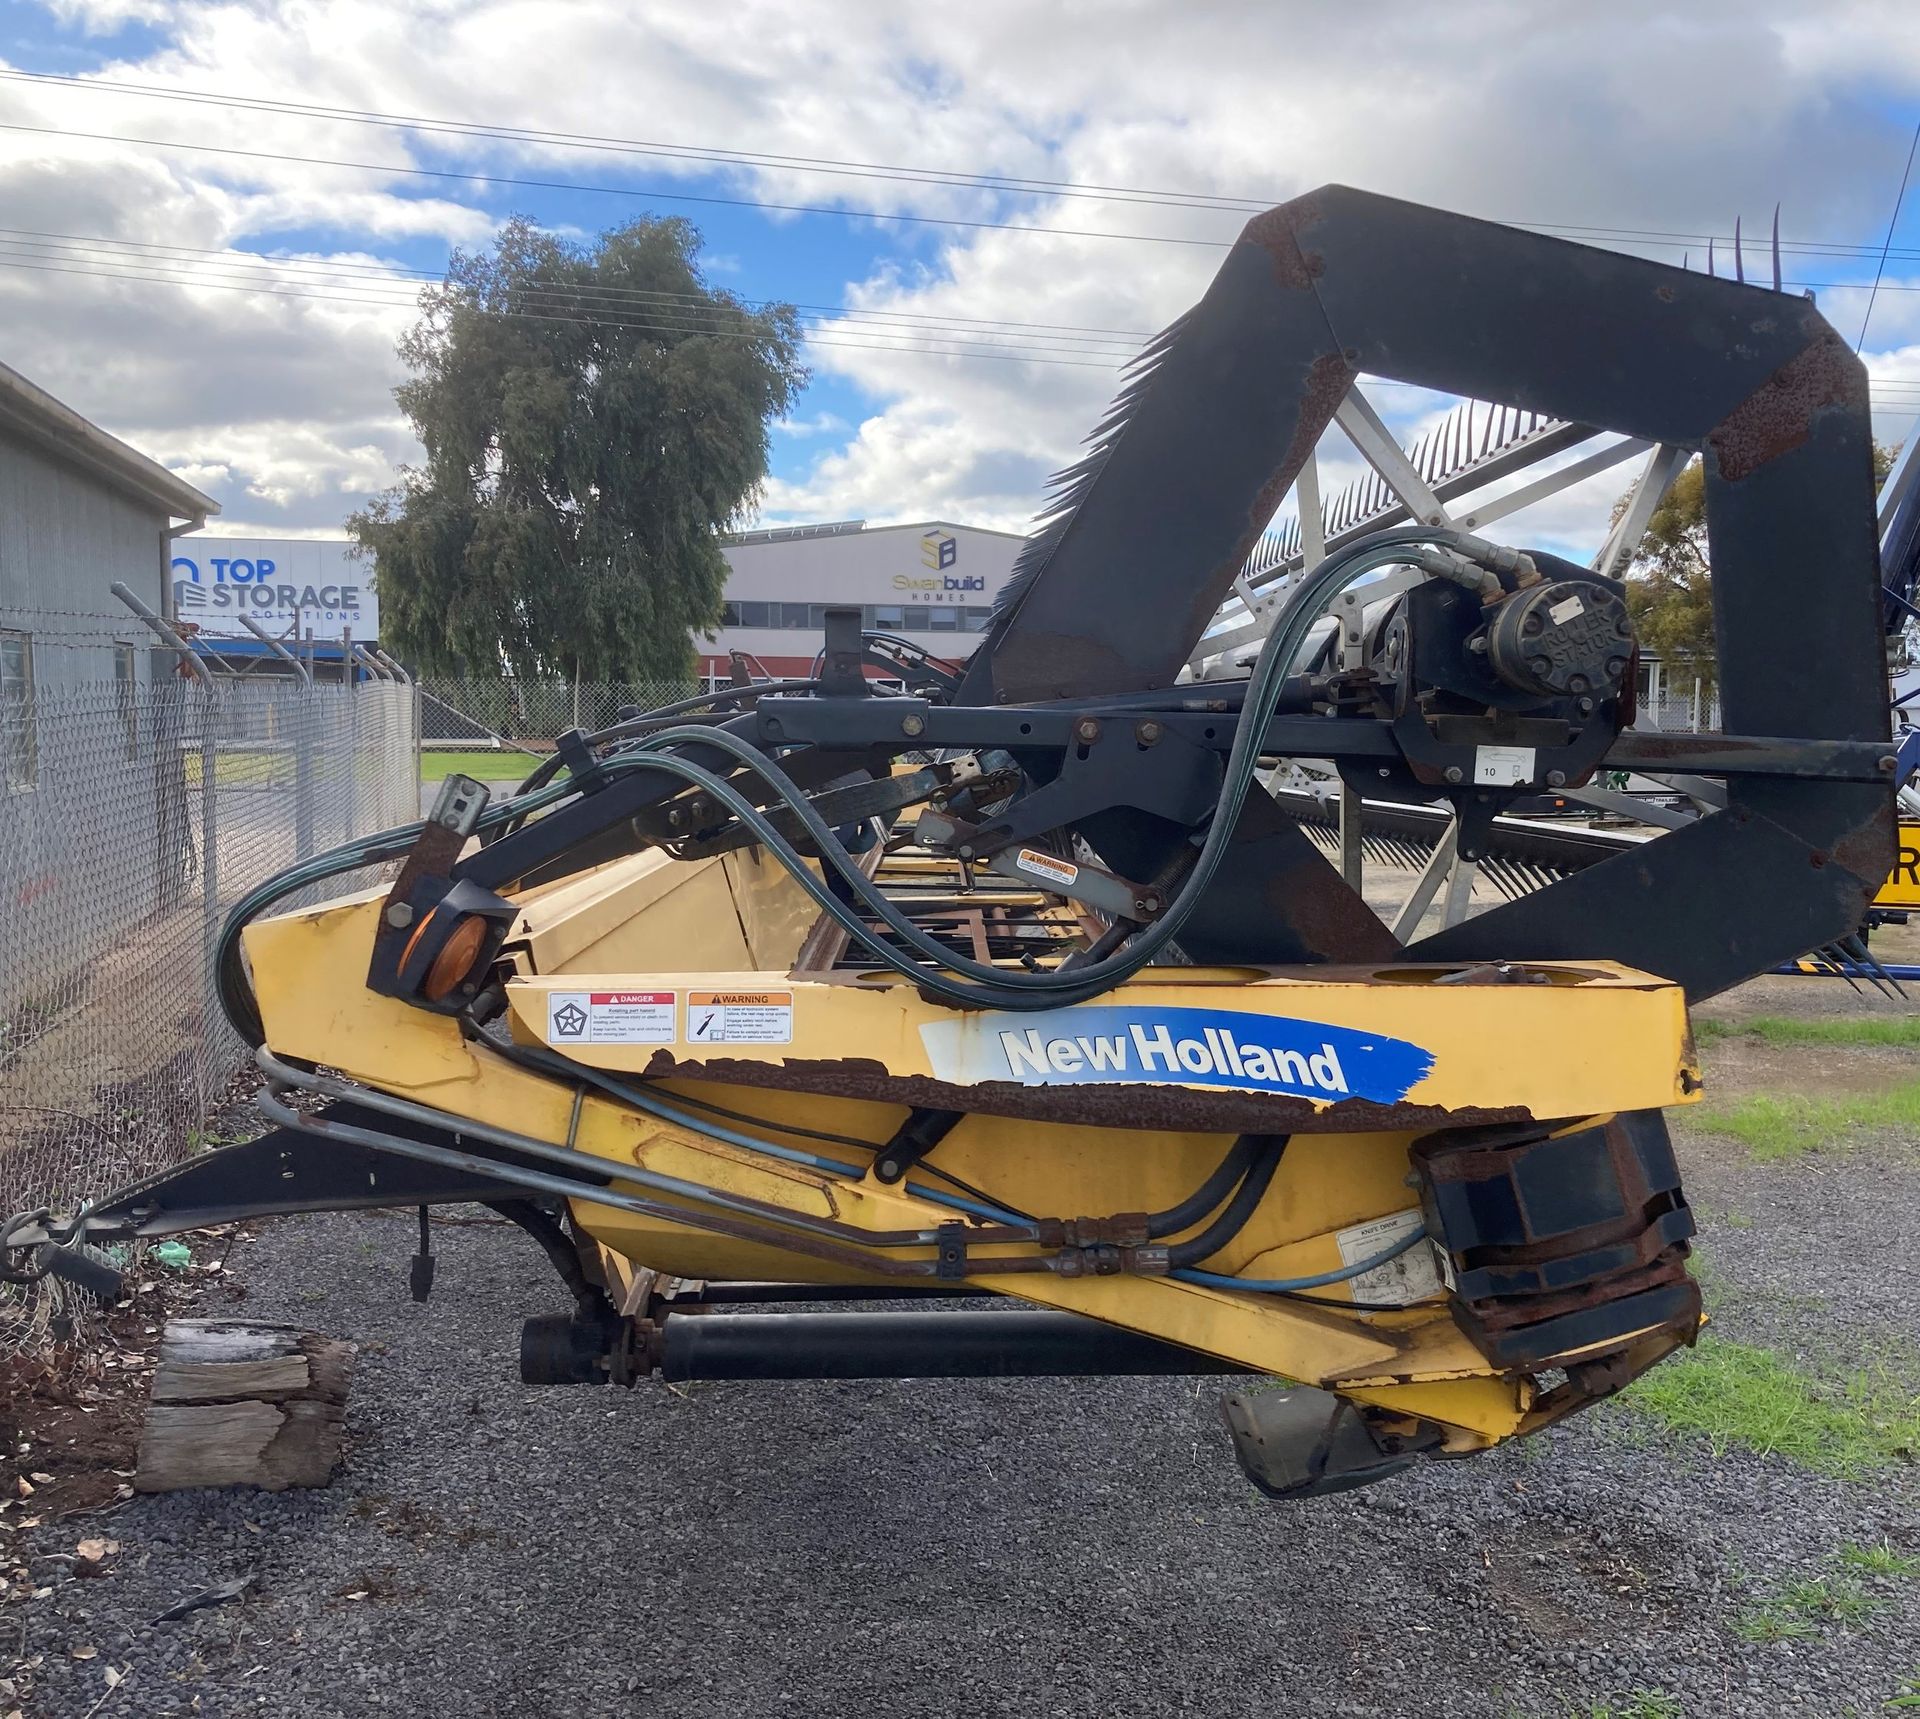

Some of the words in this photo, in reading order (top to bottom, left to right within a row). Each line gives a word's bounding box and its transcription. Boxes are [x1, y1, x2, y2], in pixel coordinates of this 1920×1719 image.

[210, 558, 276, 584] TOP
[892, 574, 985, 591] Swanbuild
[212, 584, 360, 610] STORAGE
[912, 593, 965, 602] HOMES
[1552, 628, 1619, 669] STATOR
[1484, 767, 1496, 777] 10
[1036, 855, 1069, 873] WARNING
[620, 995, 654, 1003] DANGER
[722, 995, 769, 1004] WARNING
[999, 1029, 1126, 1077] New
[1128, 1024, 1350, 1093] Holland
